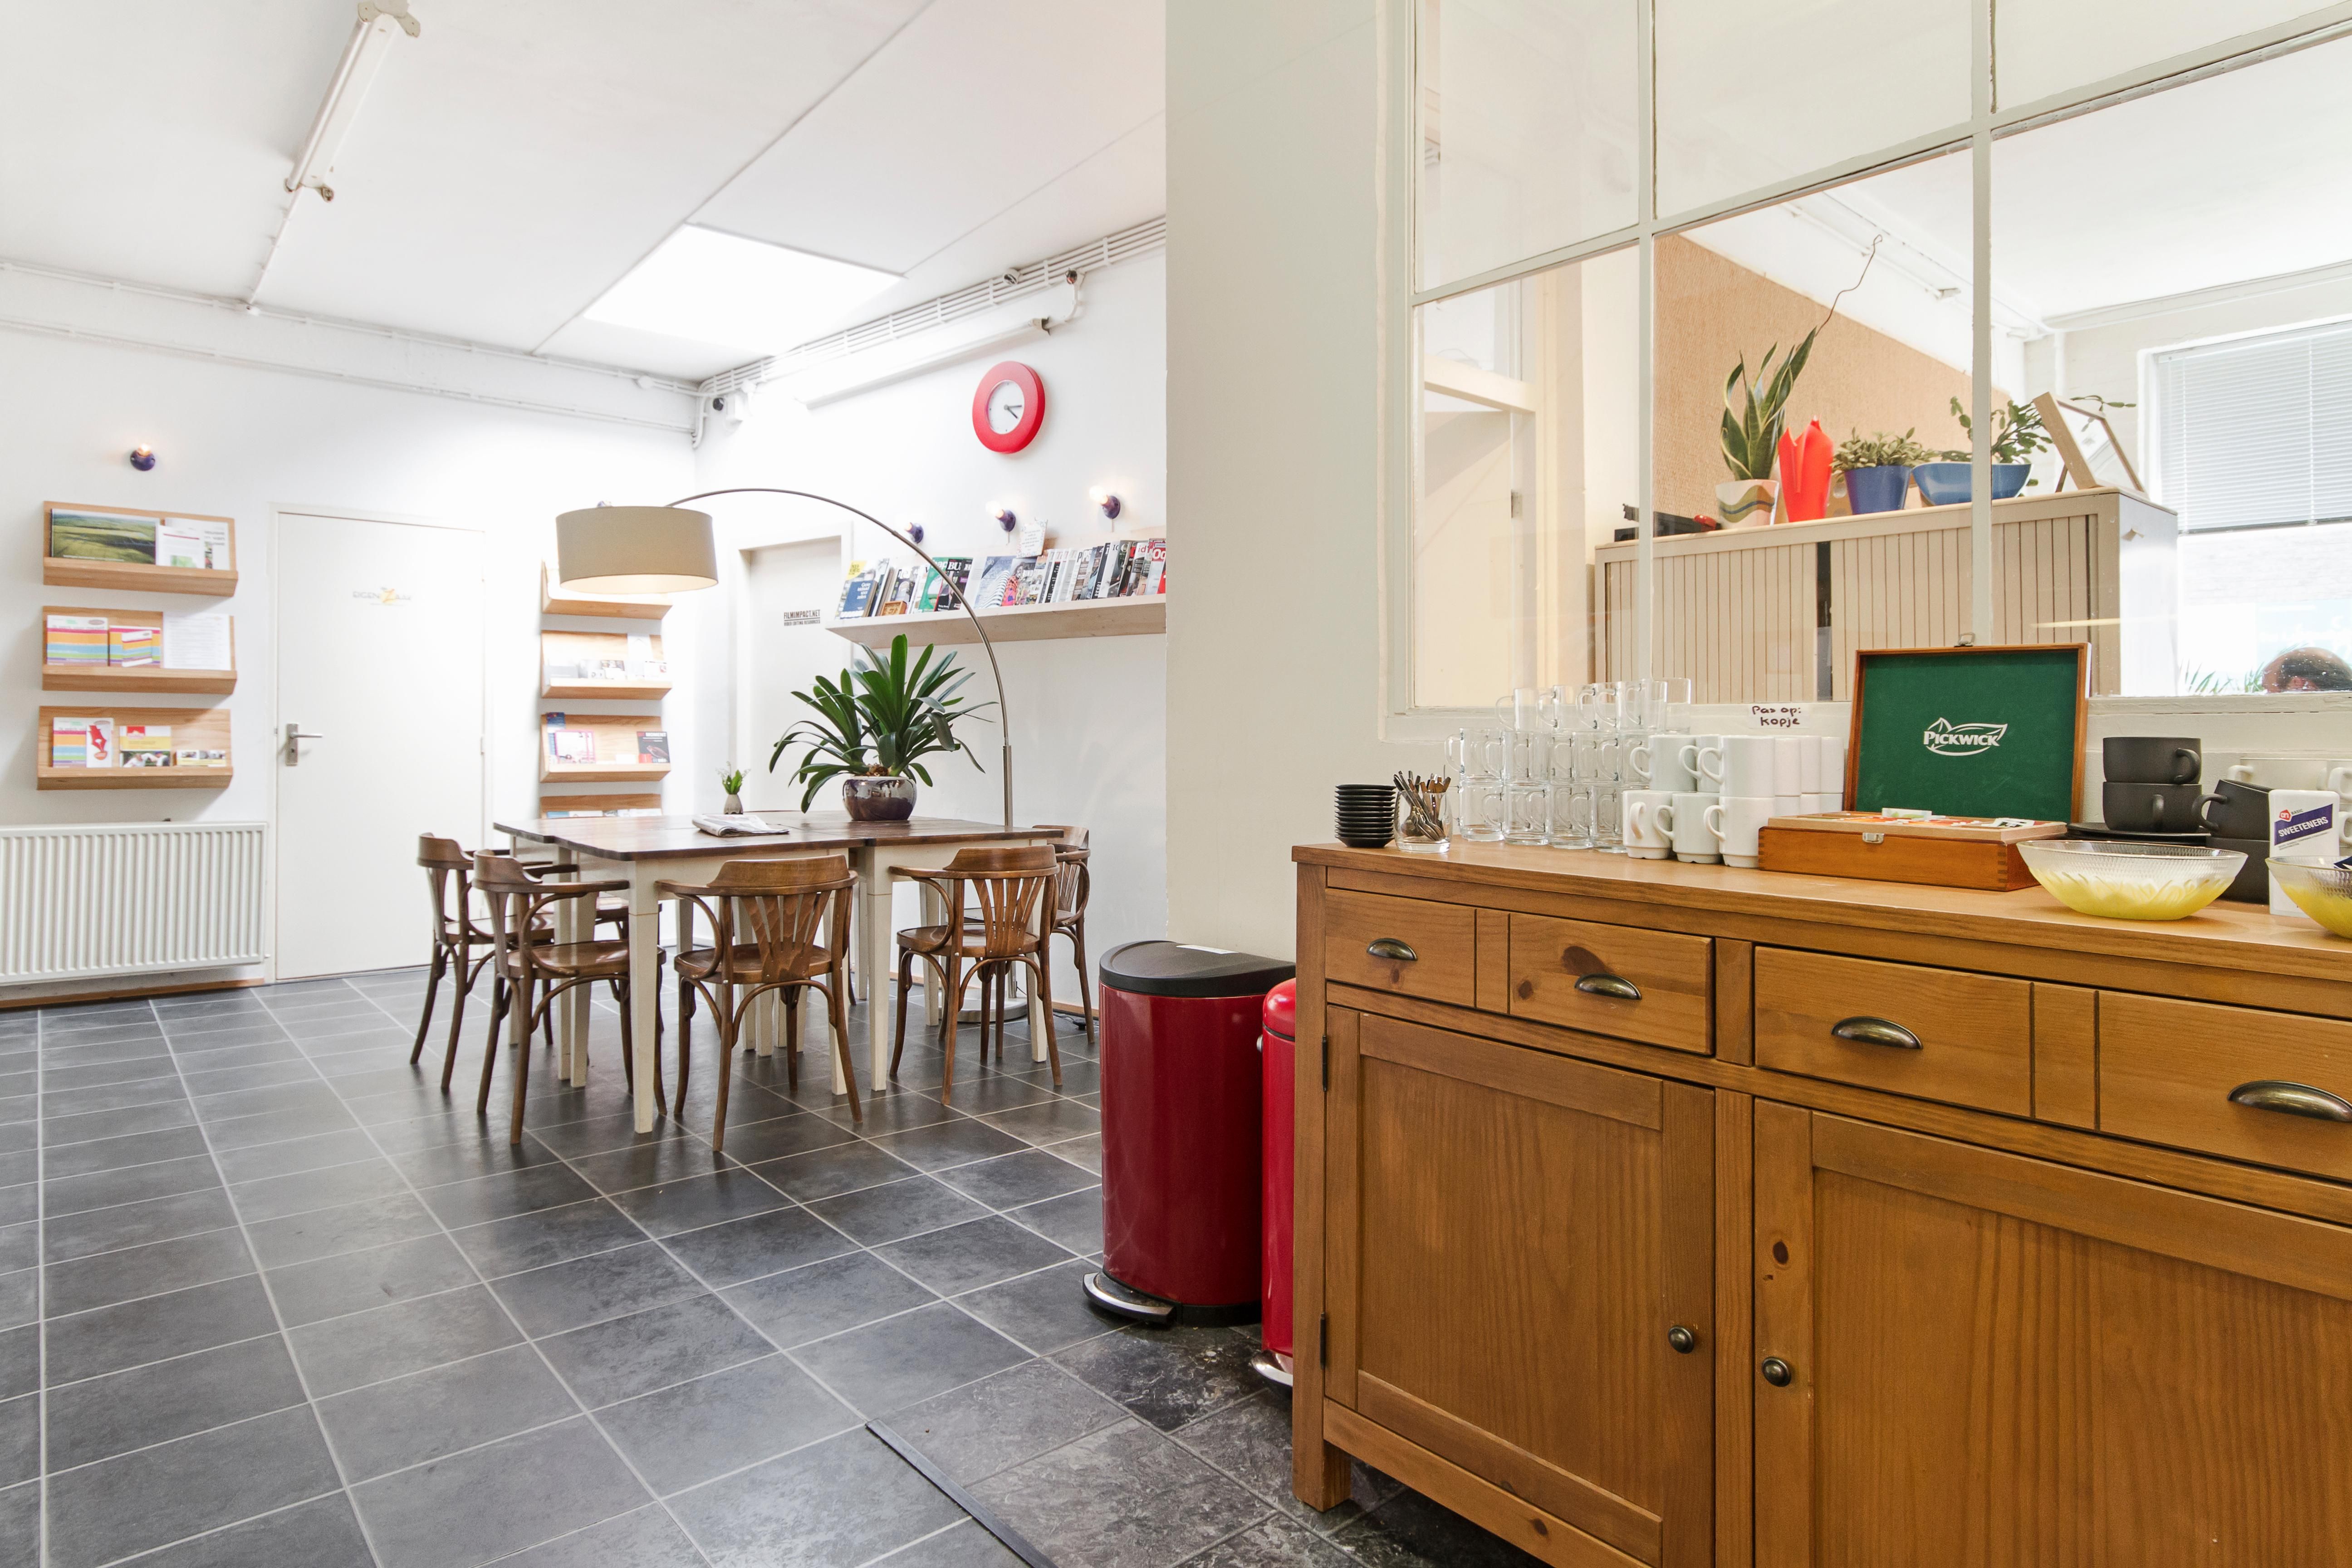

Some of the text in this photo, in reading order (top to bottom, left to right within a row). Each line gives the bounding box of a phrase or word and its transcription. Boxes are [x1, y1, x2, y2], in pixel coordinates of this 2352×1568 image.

[784, 609, 820, 619] FILMIMPACT.NET
[1752, 706, 1801, 717] Pas op:
[1923, 731, 2000, 746] PICKWICK
[2278, 817, 2329, 837] SWEETENERS
